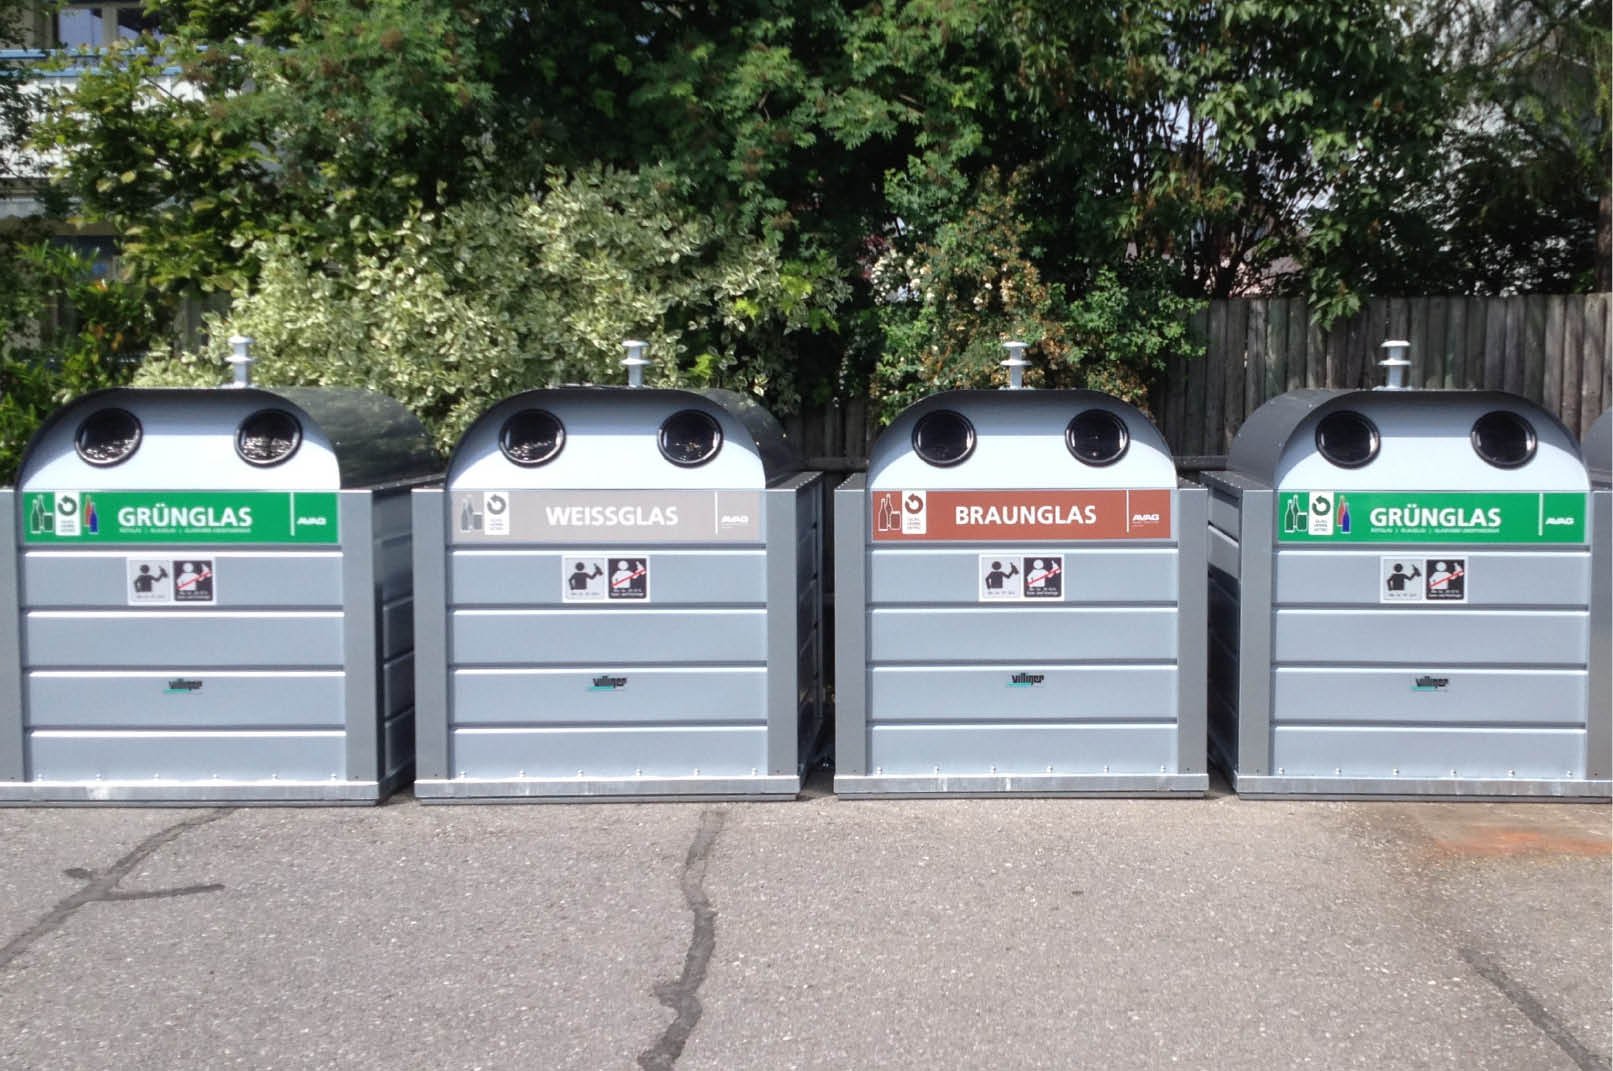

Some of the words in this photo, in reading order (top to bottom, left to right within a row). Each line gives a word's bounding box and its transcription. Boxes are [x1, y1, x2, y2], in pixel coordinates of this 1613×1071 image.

[118, 503, 252, 527] GRÜNGLAS
[545, 506, 679, 526] WEISSGLAS
[955, 505, 1097, 525] BRAUNGLAS
[1369, 503, 1502, 527] GRÜNGLAS
